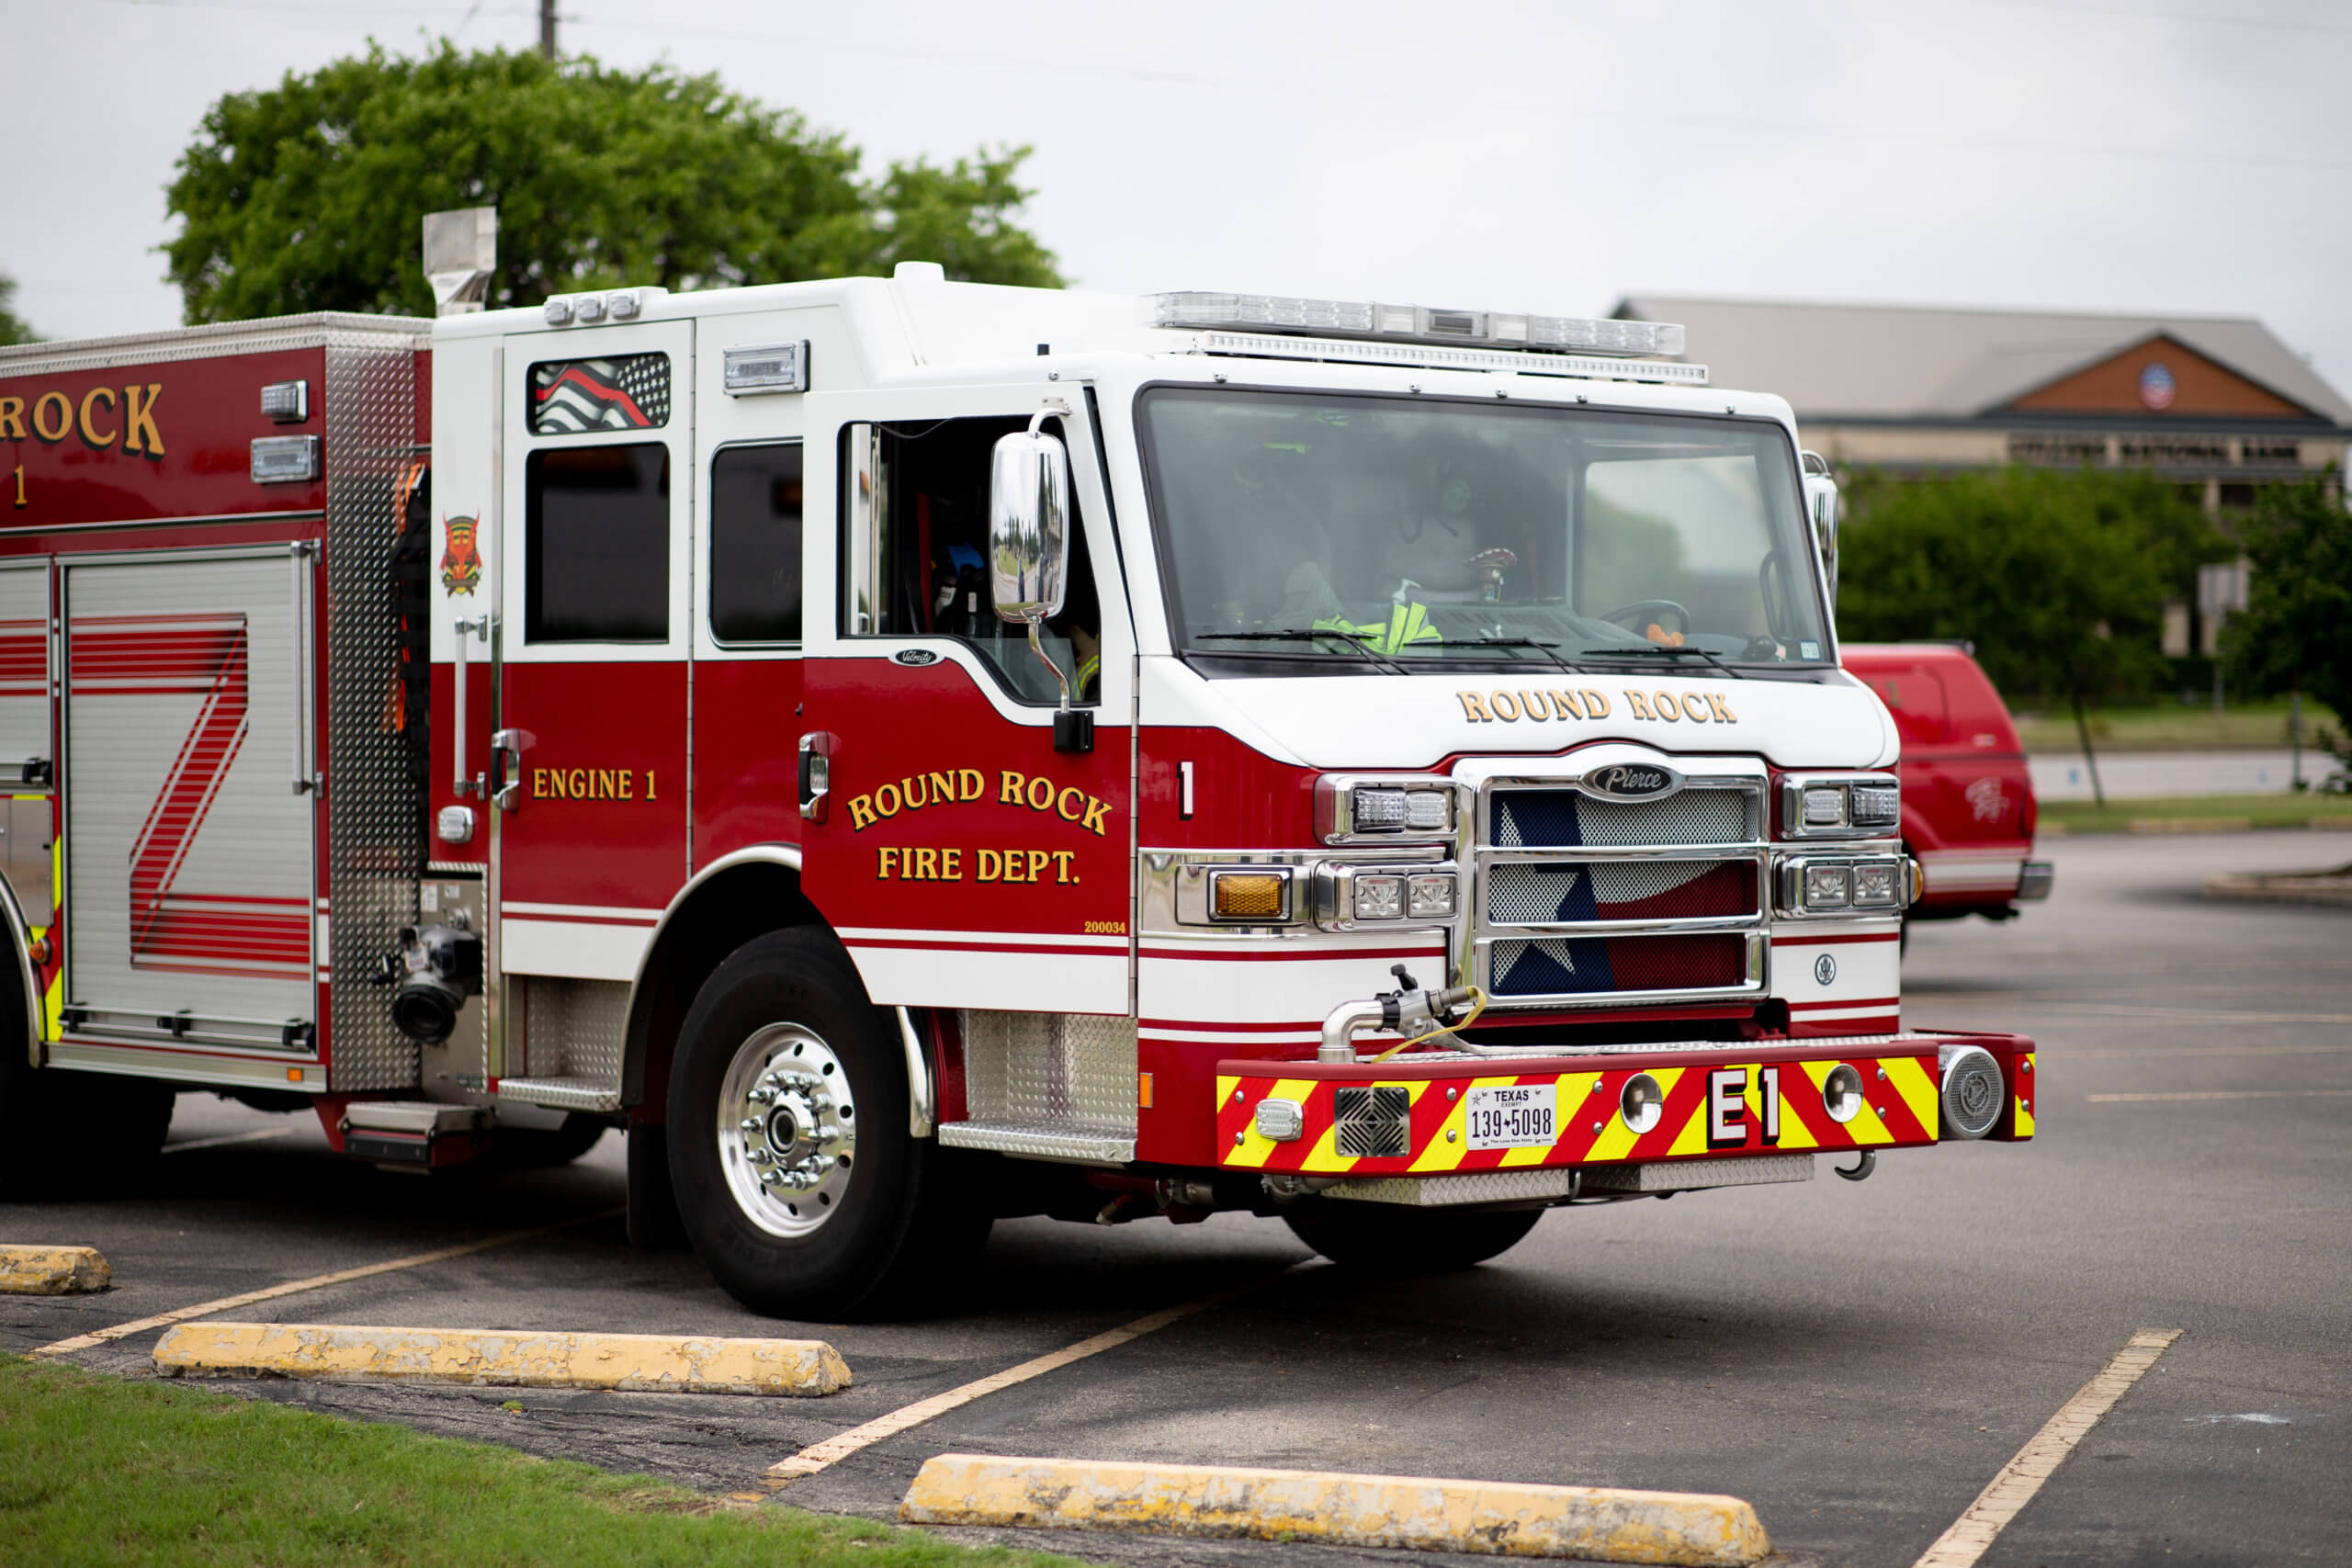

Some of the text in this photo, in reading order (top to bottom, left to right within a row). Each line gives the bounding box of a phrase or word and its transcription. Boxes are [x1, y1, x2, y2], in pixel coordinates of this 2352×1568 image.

[0, 382, 165, 462] ROCK
[13, 464, 28, 510] 1
[902, 650, 932, 664] Velocity
[1456, 689, 1737, 724] ROUND ROCK
[533, 768, 657, 801] ENGINE 1
[1178, 761, 1193, 820] 1
[1605, 767, 1662, 792] Pierce
[847, 769, 1113, 836] ROUND ROCK
[877, 847, 1080, 885] FIRE DEPT.
[1084, 920, 1125, 934] 200034
[1494, 1090, 1529, 1102] TEXAS
[1707, 1066, 1781, 1149] E1
